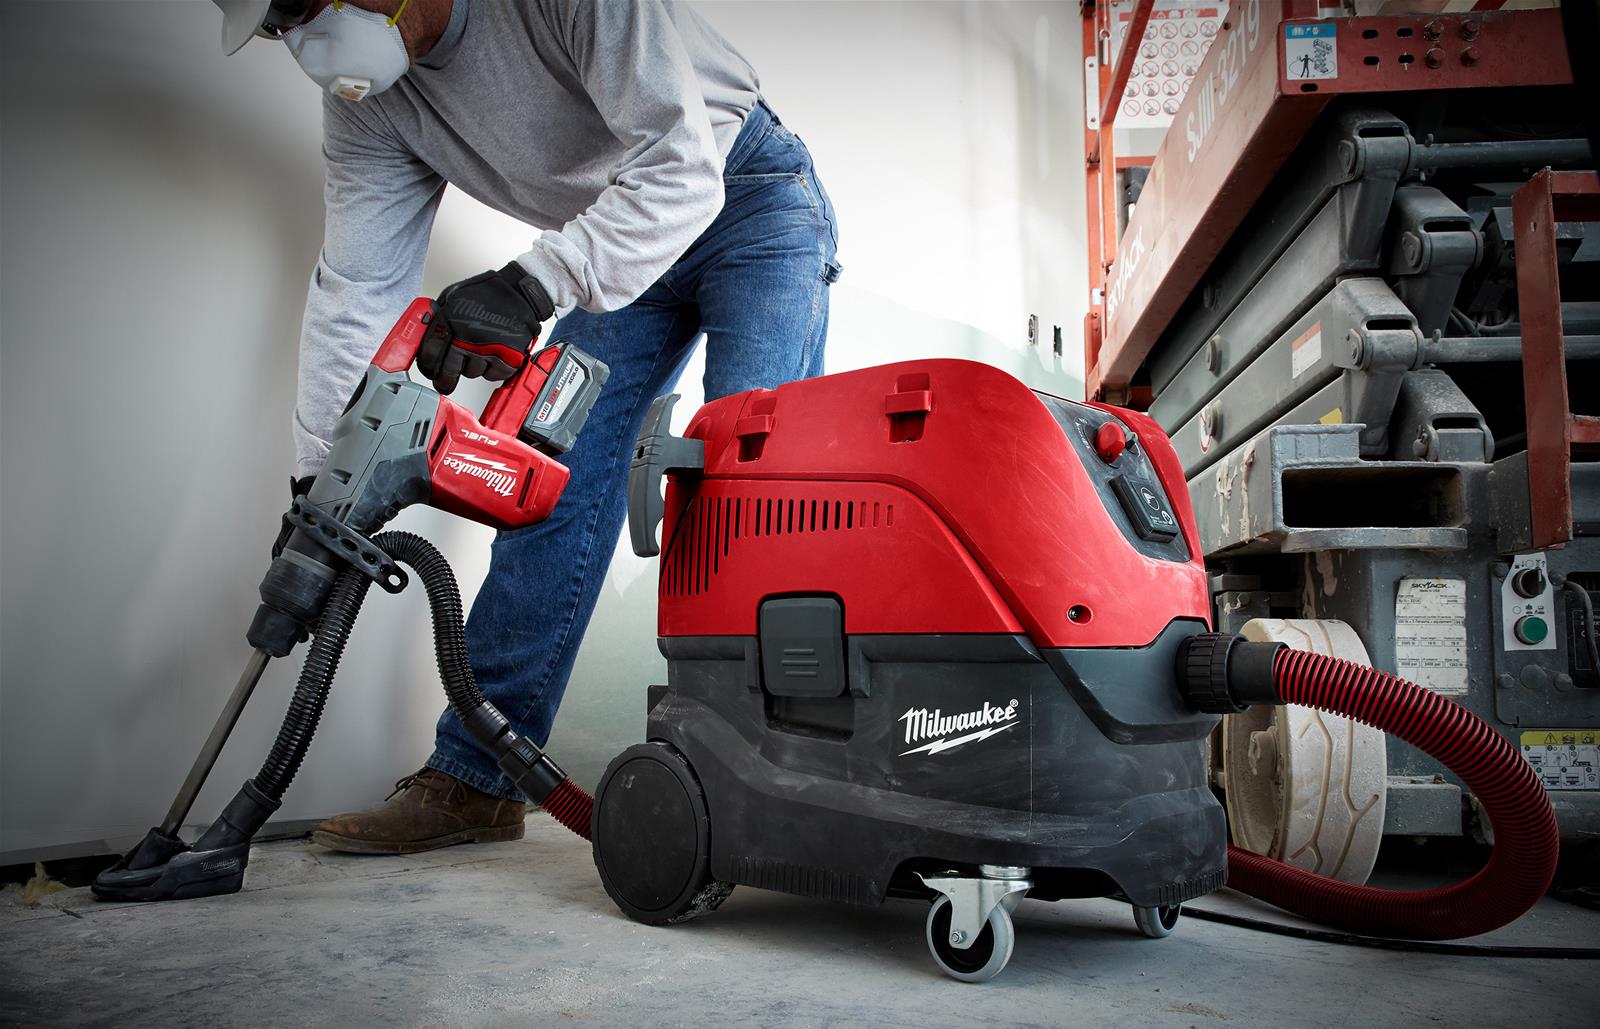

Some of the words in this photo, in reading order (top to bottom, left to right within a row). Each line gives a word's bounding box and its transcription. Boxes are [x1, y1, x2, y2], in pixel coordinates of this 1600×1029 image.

[1218, 0, 1260, 105] 3219
[461, 428, 499, 446] FUEL
[443, 456, 516, 497] Milwaukee
[1411, 581, 1448, 589] SKYJACK
[897, 699, 1019, 745] Milwaukee
